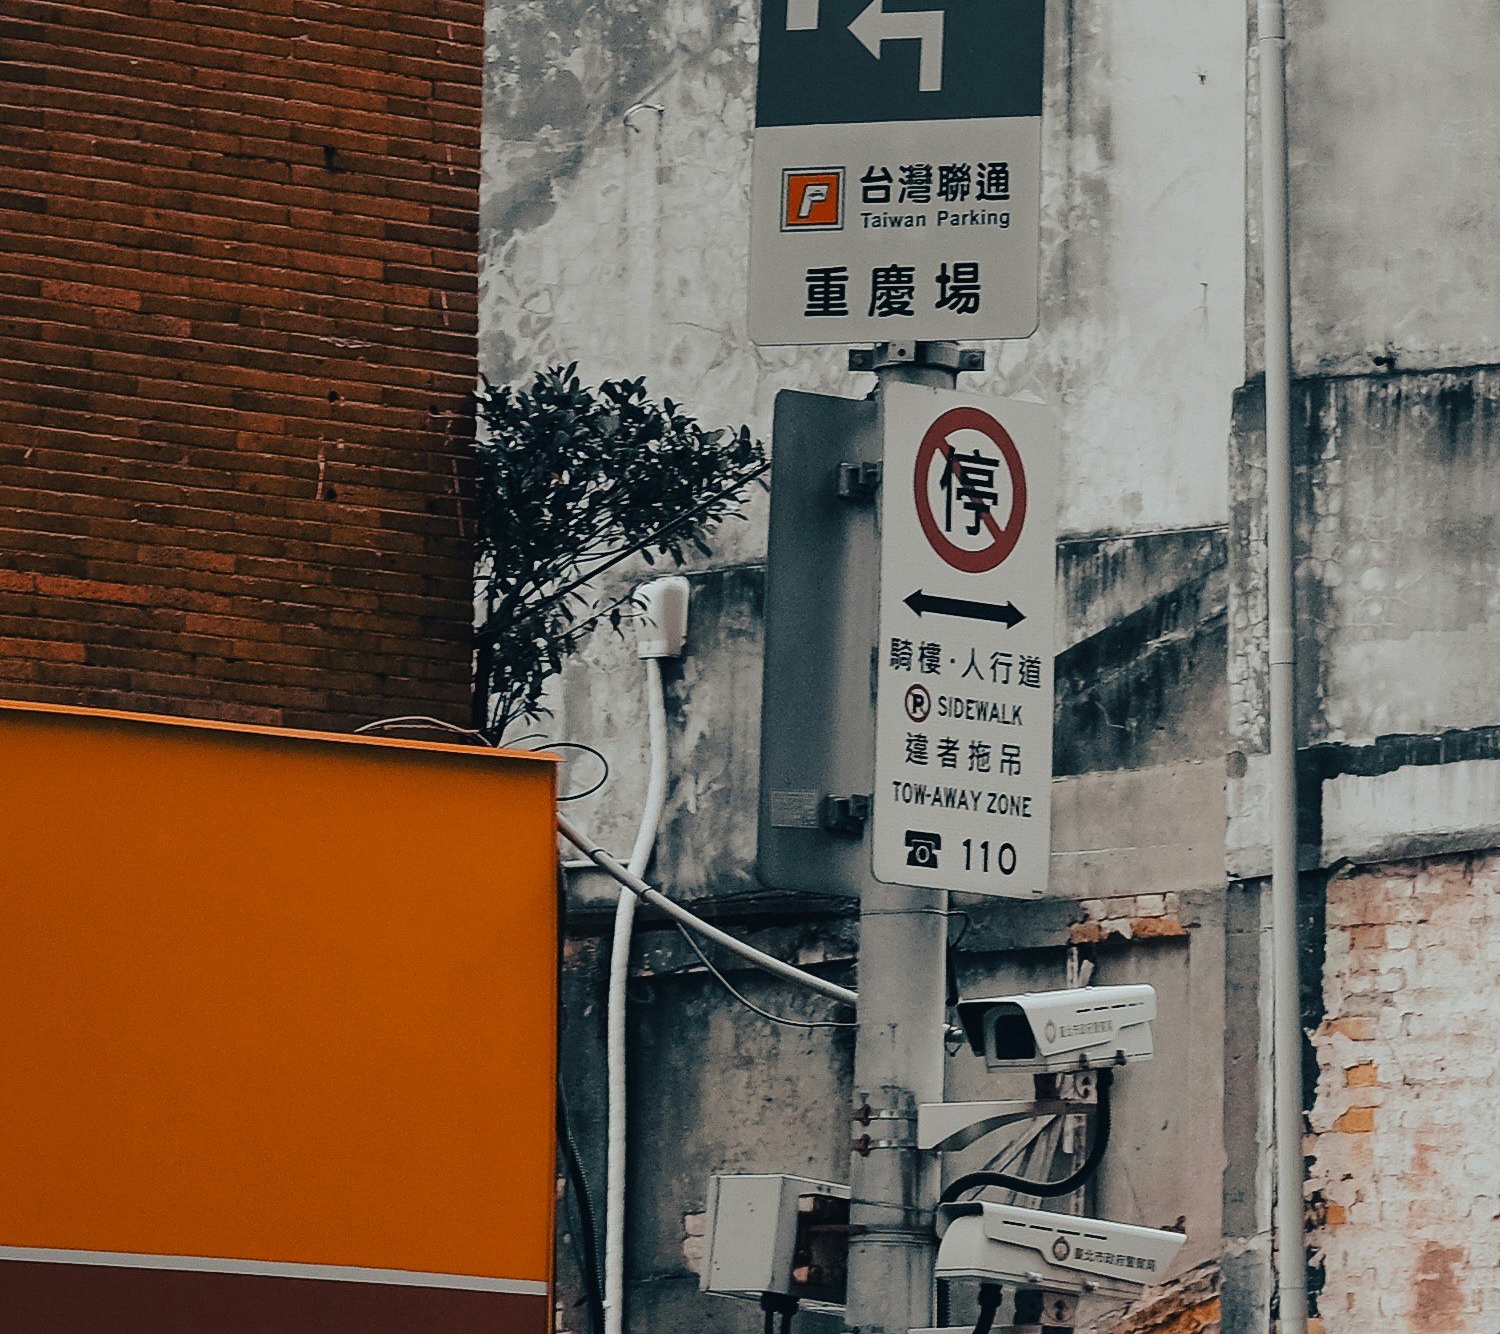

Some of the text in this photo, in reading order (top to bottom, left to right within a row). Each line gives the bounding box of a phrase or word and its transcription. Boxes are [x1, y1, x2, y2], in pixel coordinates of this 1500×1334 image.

[859, 162, 1010, 204] 台灣聯通
[860, 208, 1010, 229] Taiwan Parking
[803, 262, 982, 318] 重慶場
[939, 446, 1000, 536] 停
[937, 695, 1024, 727] SIDEWALK
[905, 732, 1023, 777] 違者拖吊
[892, 780, 1032, 818] TOW-AWAY ZONE
[962, 837, 1017, 876] 110
